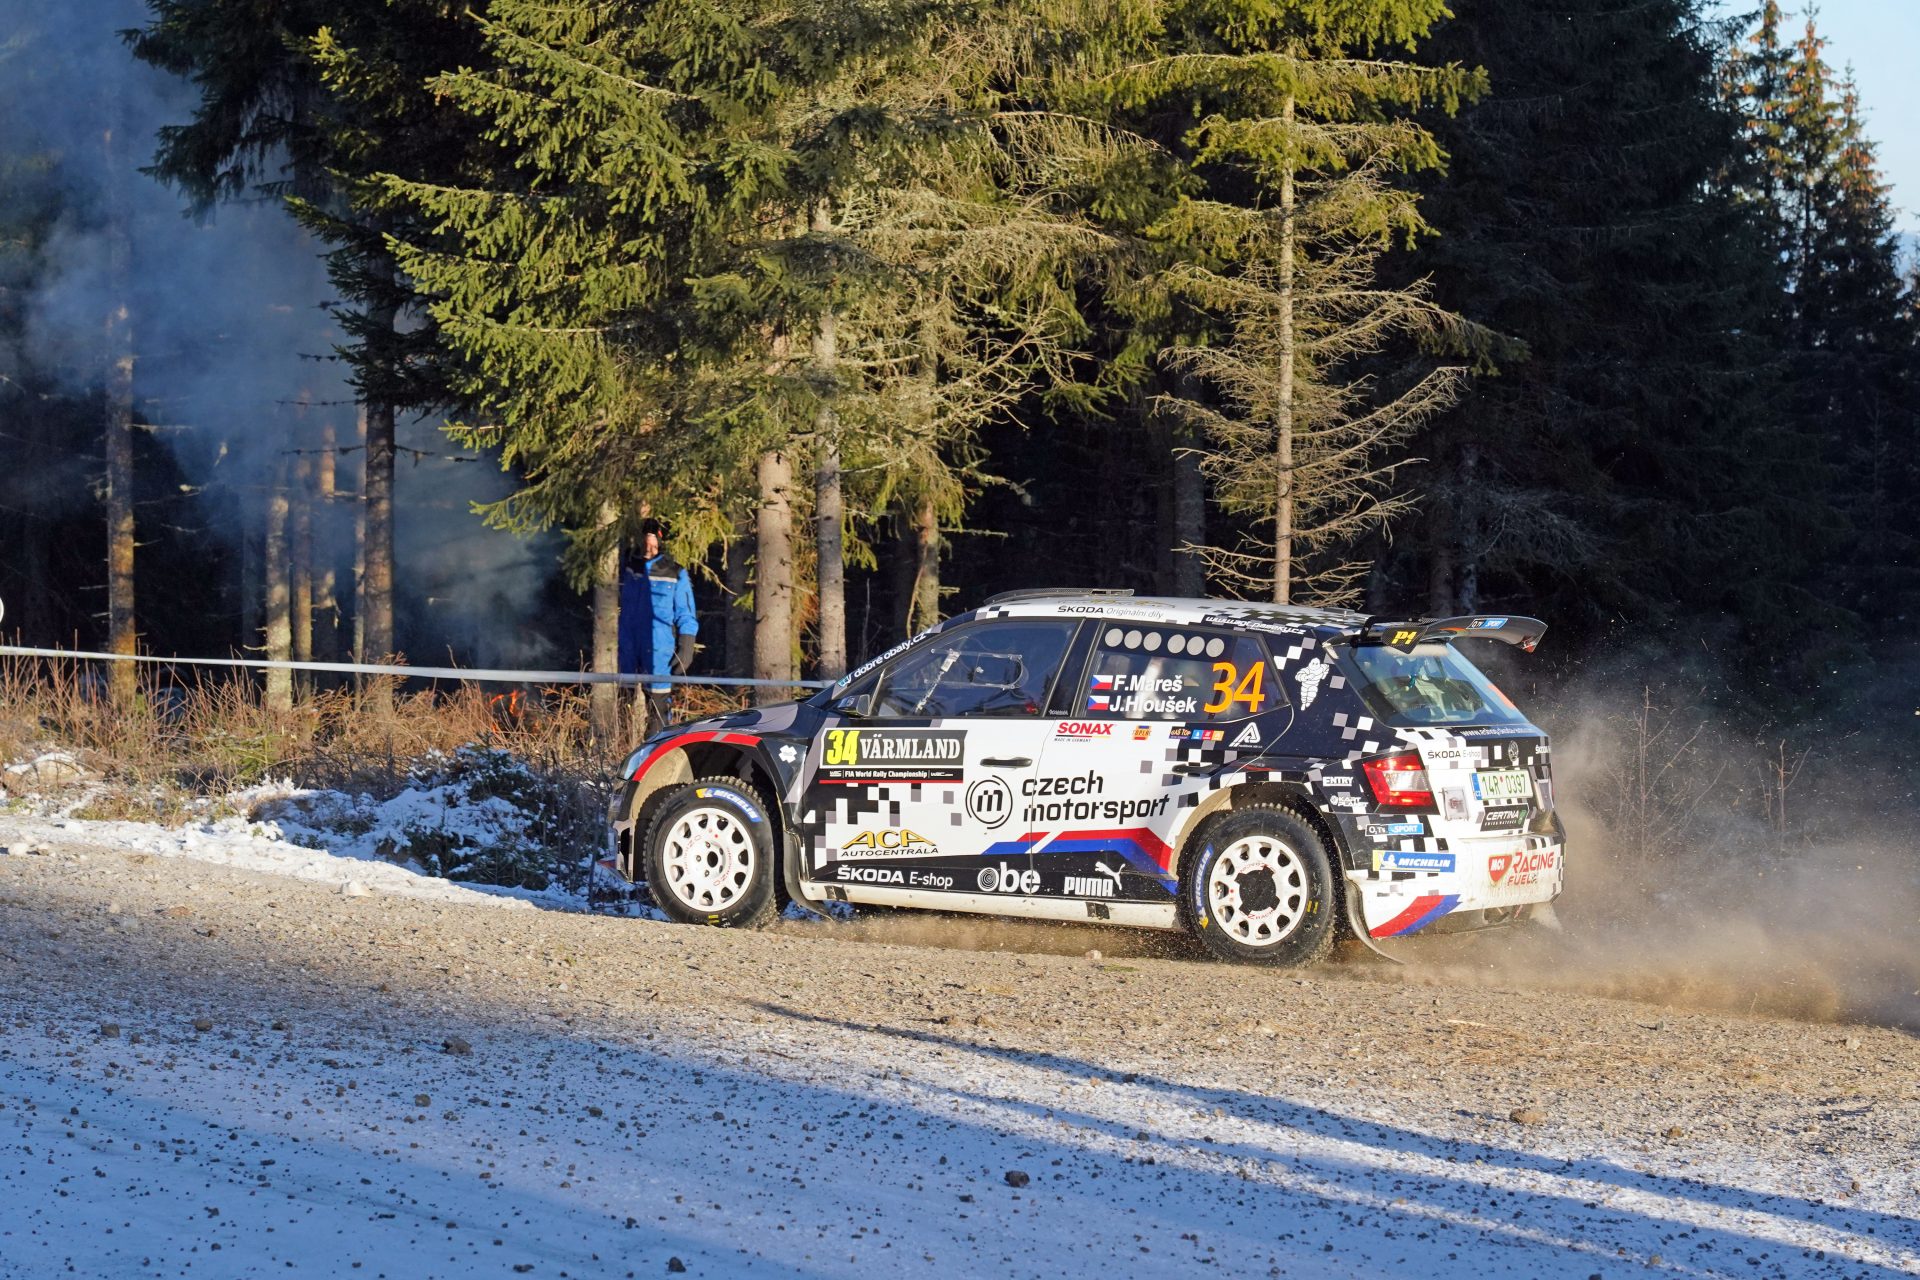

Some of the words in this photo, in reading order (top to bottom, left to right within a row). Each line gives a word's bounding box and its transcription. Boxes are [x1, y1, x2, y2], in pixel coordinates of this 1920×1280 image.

[1057, 605, 1104, 614] ŠKODA
[854, 656, 883, 678] dobré
[883, 632, 927, 660] obaly.cz
[1112, 674, 1183, 692] F.Mareš
[1203, 661, 1265, 714] 34
[1109, 695, 1198, 714] J.Hloušek
[1057, 722, 1114, 735] SONAX
[826, 730, 861, 765] 34
[860, 733, 961, 759] VÄRMLAND
[1427, 750, 1461, 759] ŠKODA
[844, 770, 855, 778] FIA
[855, 770, 872, 778] World
[872, 770, 887, 779] Rally
[888, 770, 928, 779] Championship
[1022, 769, 1104, 797] czech
[1482, 775, 1501, 796] 14R
[1505, 774, 1526, 794] 0397
[713, 789, 758, 819] MICHELIN
[1023, 794, 1170, 824] motorsport
[1486, 810, 1520, 821] CERTINA
[841, 828, 937, 850] ACA
[1394, 825, 1418, 833] SPORT
[841, 847, 939, 857] AUTOCENTRÁLA
[1512, 851, 1555, 873] RACING
[1398, 858, 1451, 868] MICHELIN
[836, 865, 905, 884] ŠKODA
[909, 871, 954, 889] E-shop
[1063, 876, 1114, 897] PUMA
[1195, 849, 1211, 907] MICHELIN
